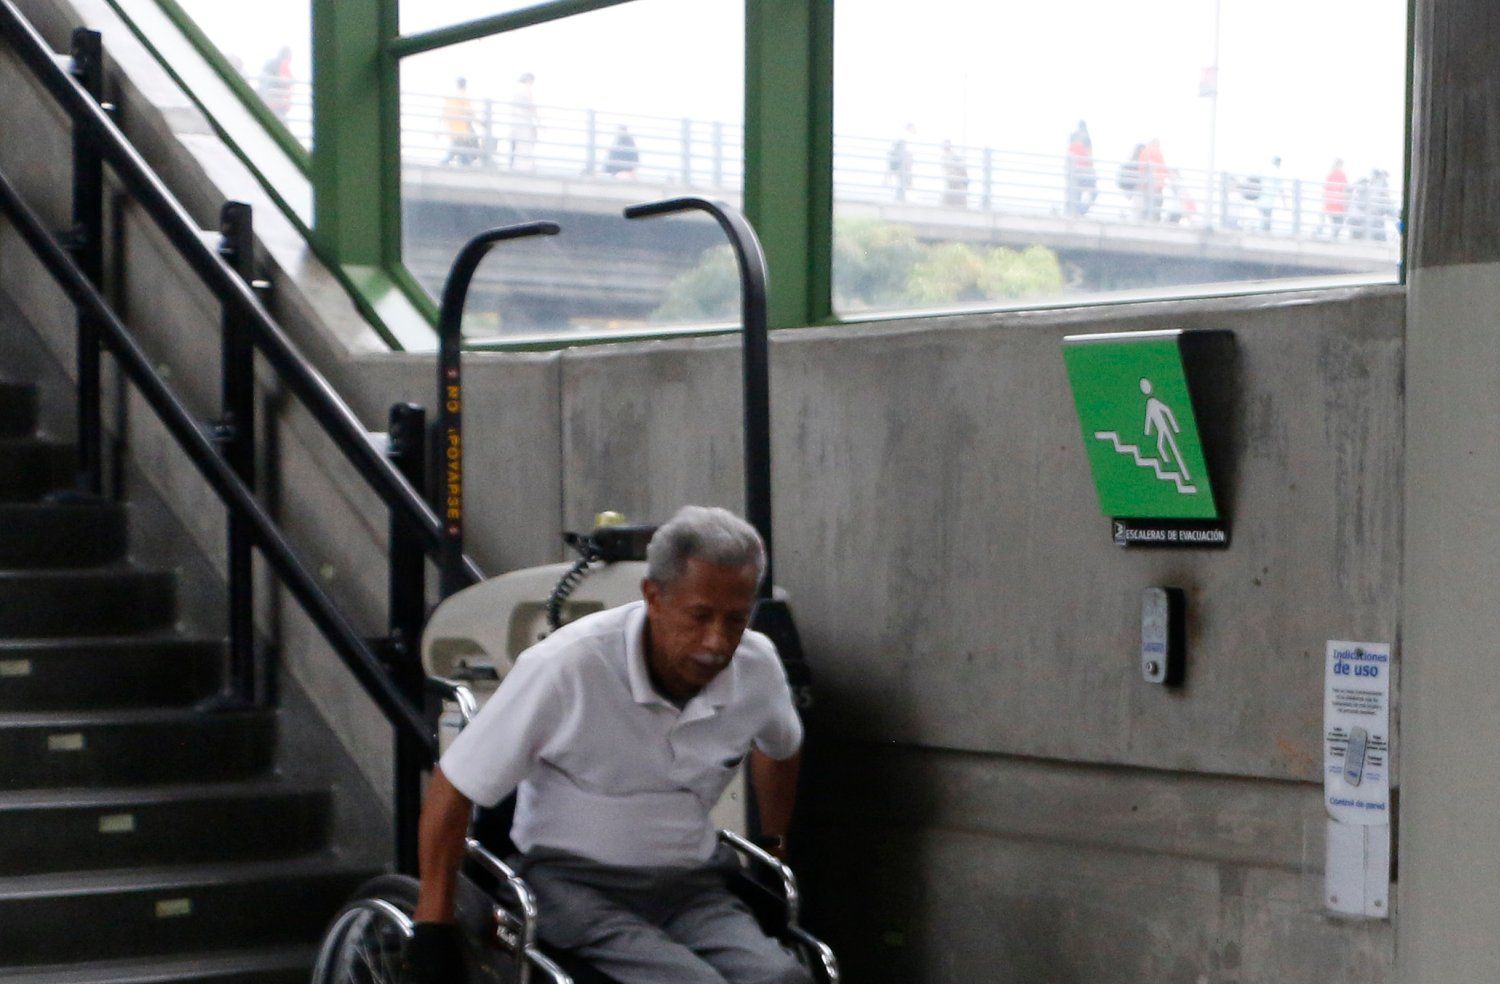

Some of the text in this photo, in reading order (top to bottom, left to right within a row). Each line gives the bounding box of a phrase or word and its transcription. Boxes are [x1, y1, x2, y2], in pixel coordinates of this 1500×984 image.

[447, 385, 461, 518] NO POYARSE
[1126, 529, 1224, 541] ESCALERAS DE EVACUACIÓN
[1333, 660, 1378, 677] de uso
